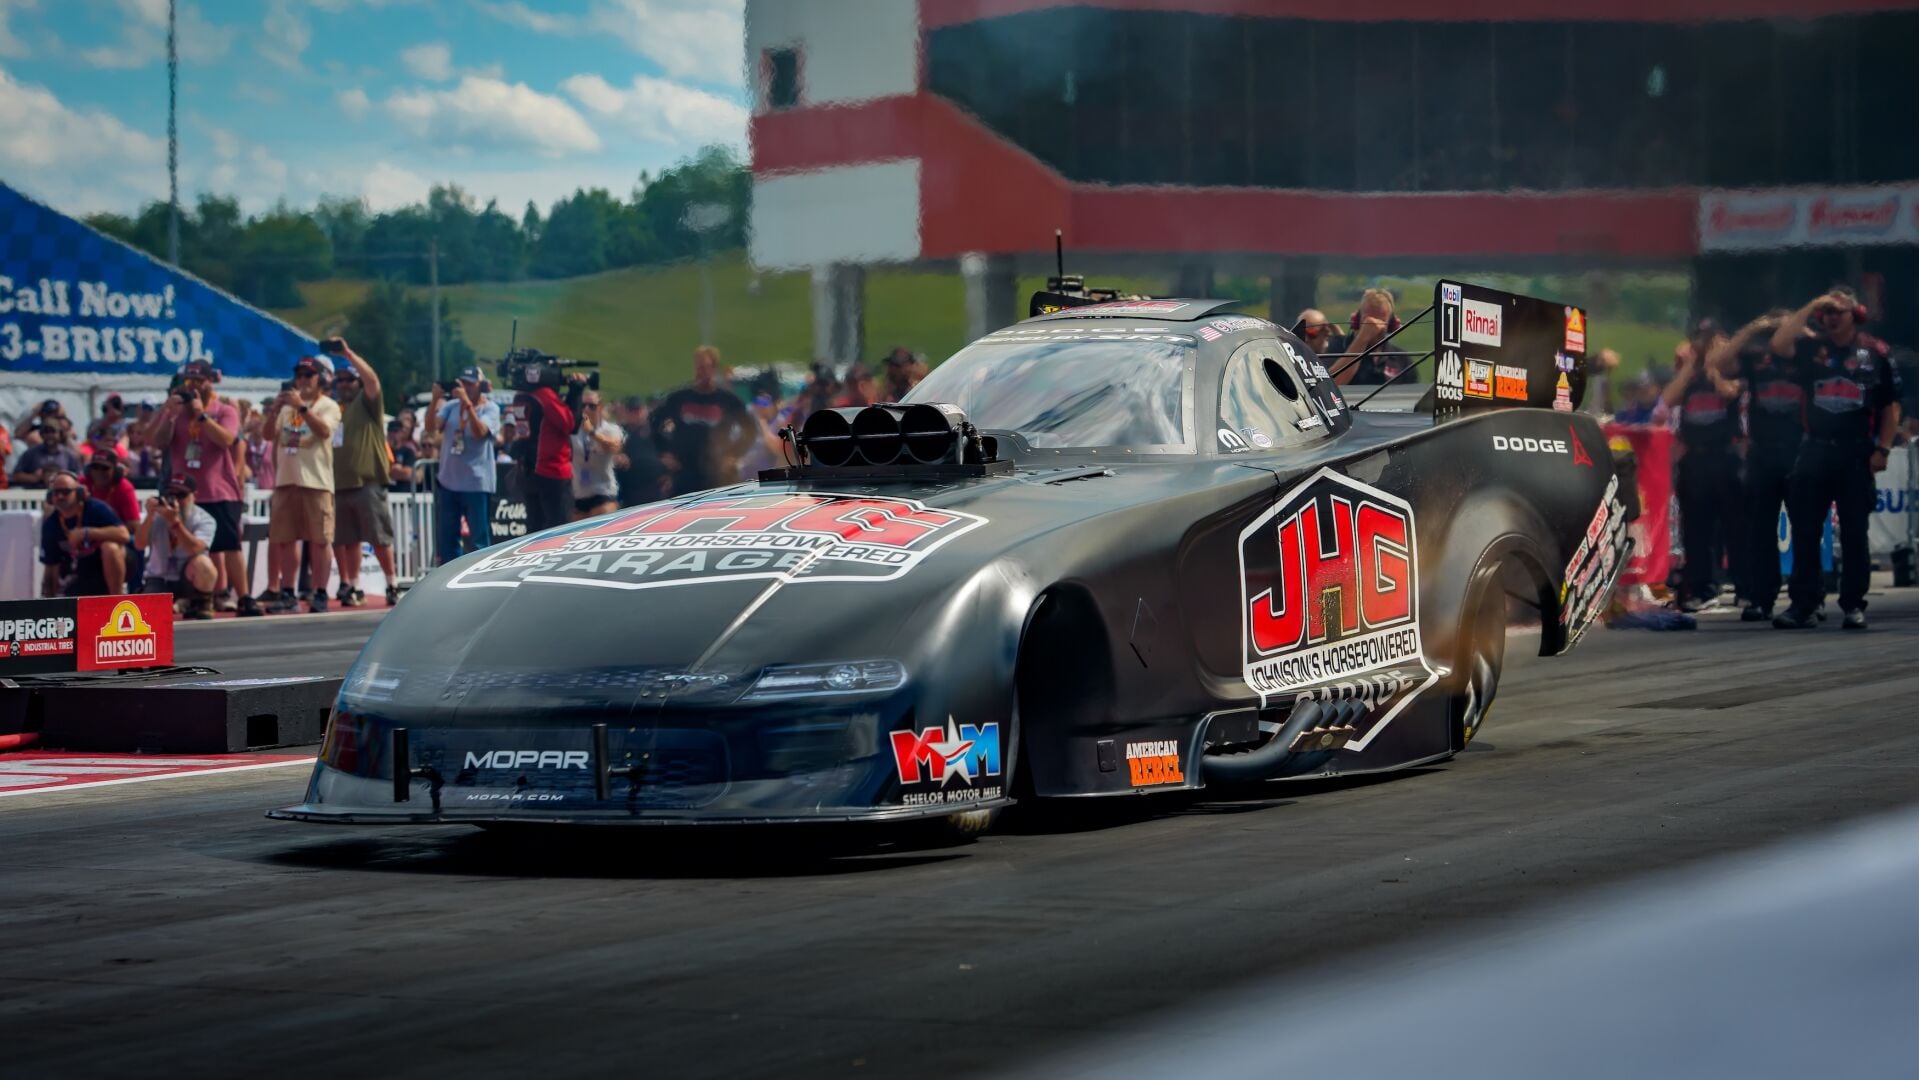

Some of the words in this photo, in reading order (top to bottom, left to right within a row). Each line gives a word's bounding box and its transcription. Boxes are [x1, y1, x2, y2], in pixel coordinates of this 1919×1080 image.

[0, 275, 70, 316] Call
[78, 281, 176, 319] Now!
[1443, 287, 1460, 301] Mobil
[1447, 307, 1455, 340] 1
[1466, 309, 1498, 336] Rinnai
[0, 322, 214, 365] 3-BRISTOL
[1437, 349, 1464, 388] MAC
[1437, 386, 1464, 401] TOOLS
[1492, 435, 1569, 454] DODGE
[513, 494, 962, 556] JHG
[645, 533, 911, 565] HORSEPOWERED
[518, 550, 822, 580] GARAGE
[1249, 494, 1409, 656] JHG
[24, 642, 57, 652] INDUSTRIAL
[58, 641, 74, 650] TIRES
[99, 638, 154, 658] MISSION
[1251, 652, 1321, 692] JOHNSON'S
[1321, 628, 1418, 676] HORSEPOWERED
[463, 750, 590, 770] MOPAR
[1125, 740, 1178, 760] AMERICAN
[1128, 755, 1185, 787] REBEL
[466, 793, 565, 801] MOPAR.COM
[902, 792, 944, 806] SHELOR
[947, 789, 981, 803] MOTOR
[982, 786, 1002, 799] MILE
